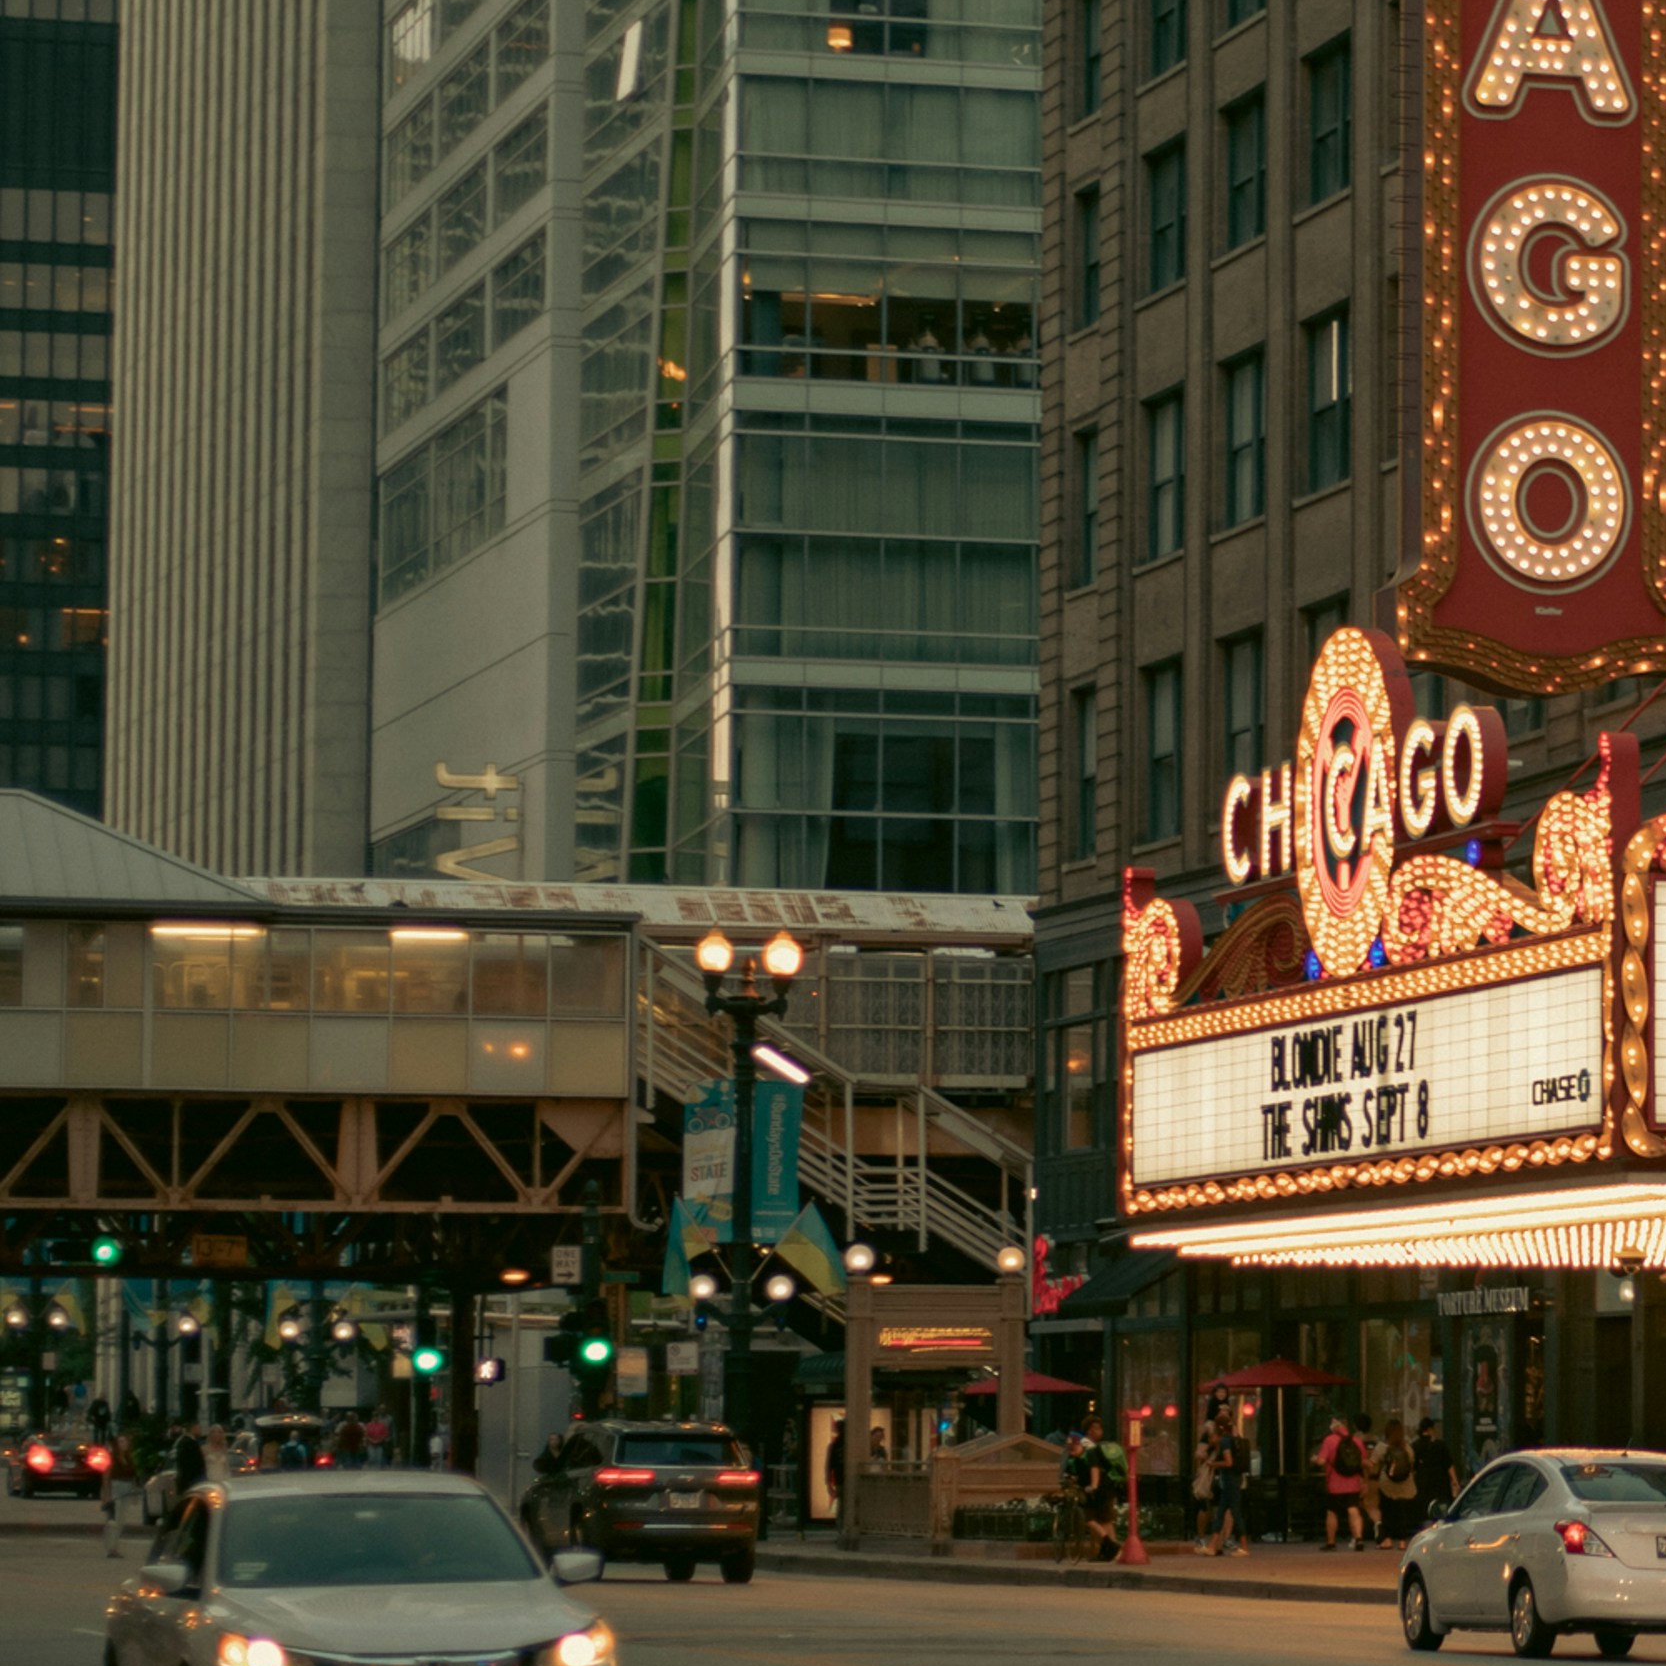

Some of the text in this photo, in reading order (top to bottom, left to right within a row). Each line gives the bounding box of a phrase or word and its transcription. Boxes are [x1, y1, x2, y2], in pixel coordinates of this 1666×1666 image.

[1221, 702, 1484, 887] CHICAGO
[1271, 1010, 1417, 1092] BLONDIE AUG 27
[1532, 1074, 1577, 1106] CHASE
[1262, 1079, 1429, 1161] THE SHINS SEPT 8
[690, 1162, 728, 1182] STATE
[555, 1250, 577, 1259] ONE
[555, 1260, 577, 1269] WAY
